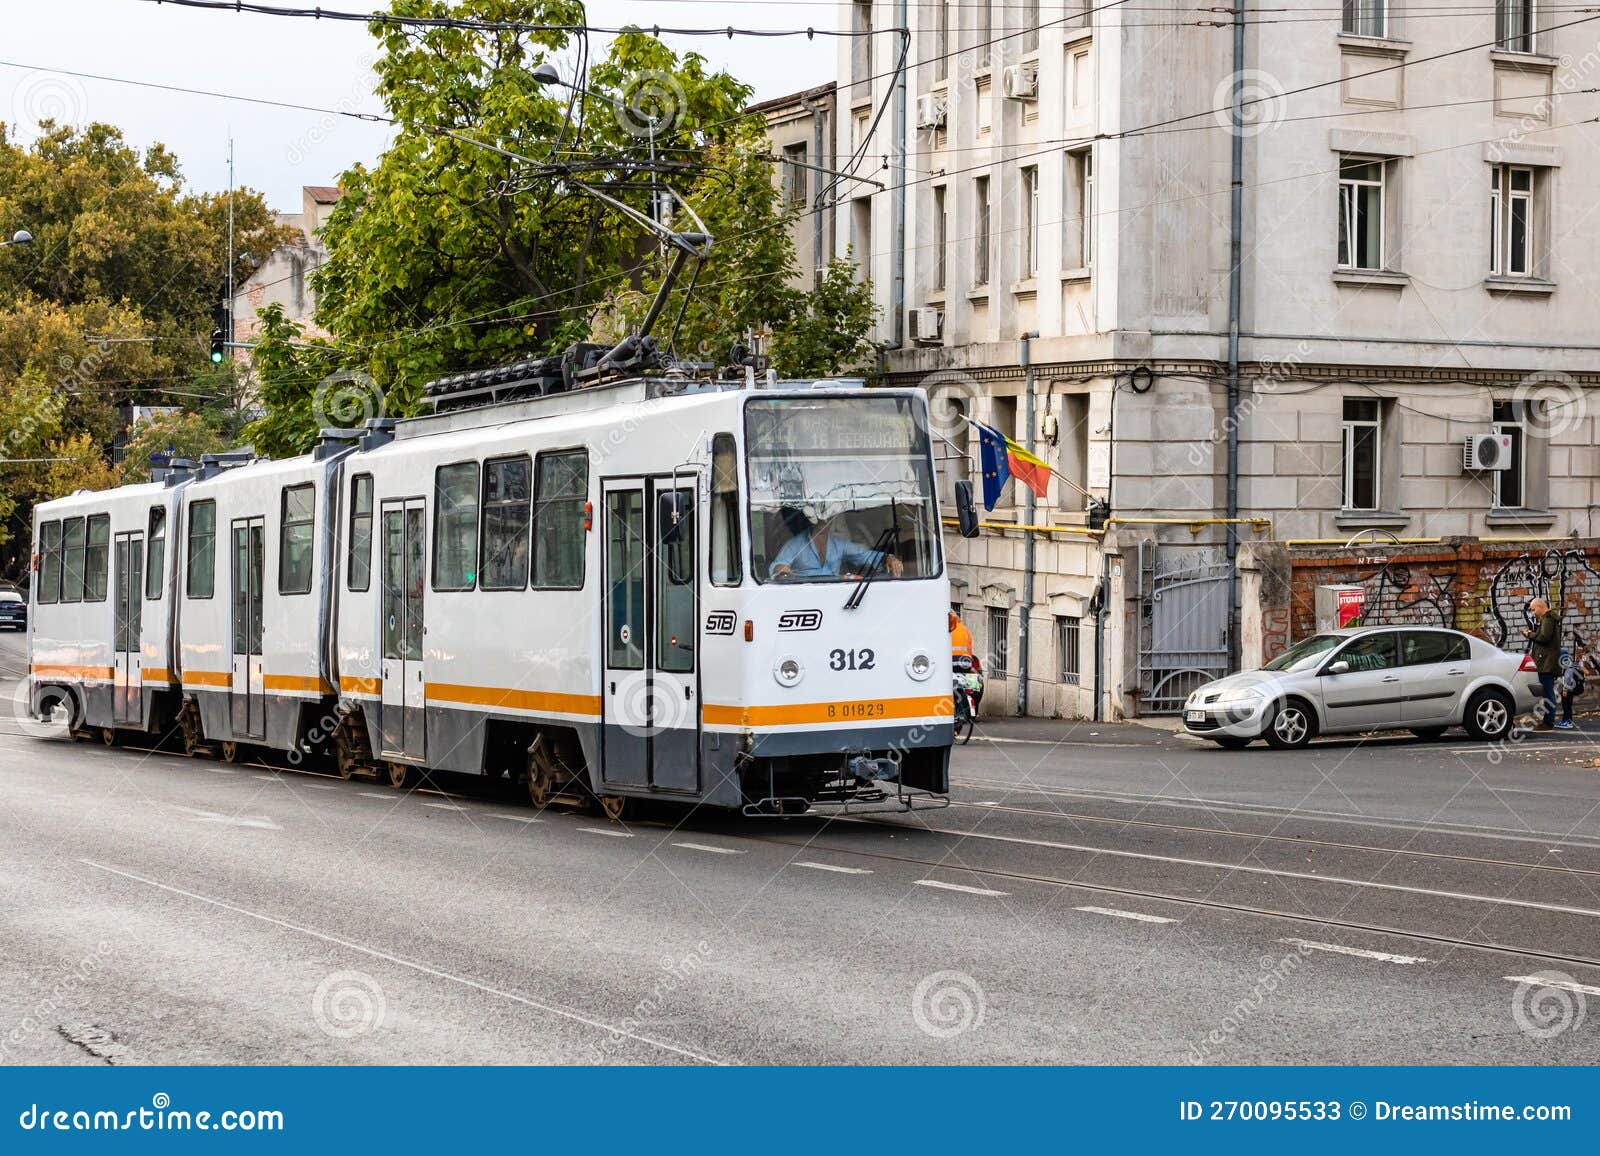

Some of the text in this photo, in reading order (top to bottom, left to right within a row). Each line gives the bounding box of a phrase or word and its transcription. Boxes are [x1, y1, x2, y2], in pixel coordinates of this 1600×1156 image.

[706, 613, 735, 633] STB
[778, 611, 821, 630] STB
[829, 648, 876, 671] 312
[827, 703, 885, 718] B 01829
